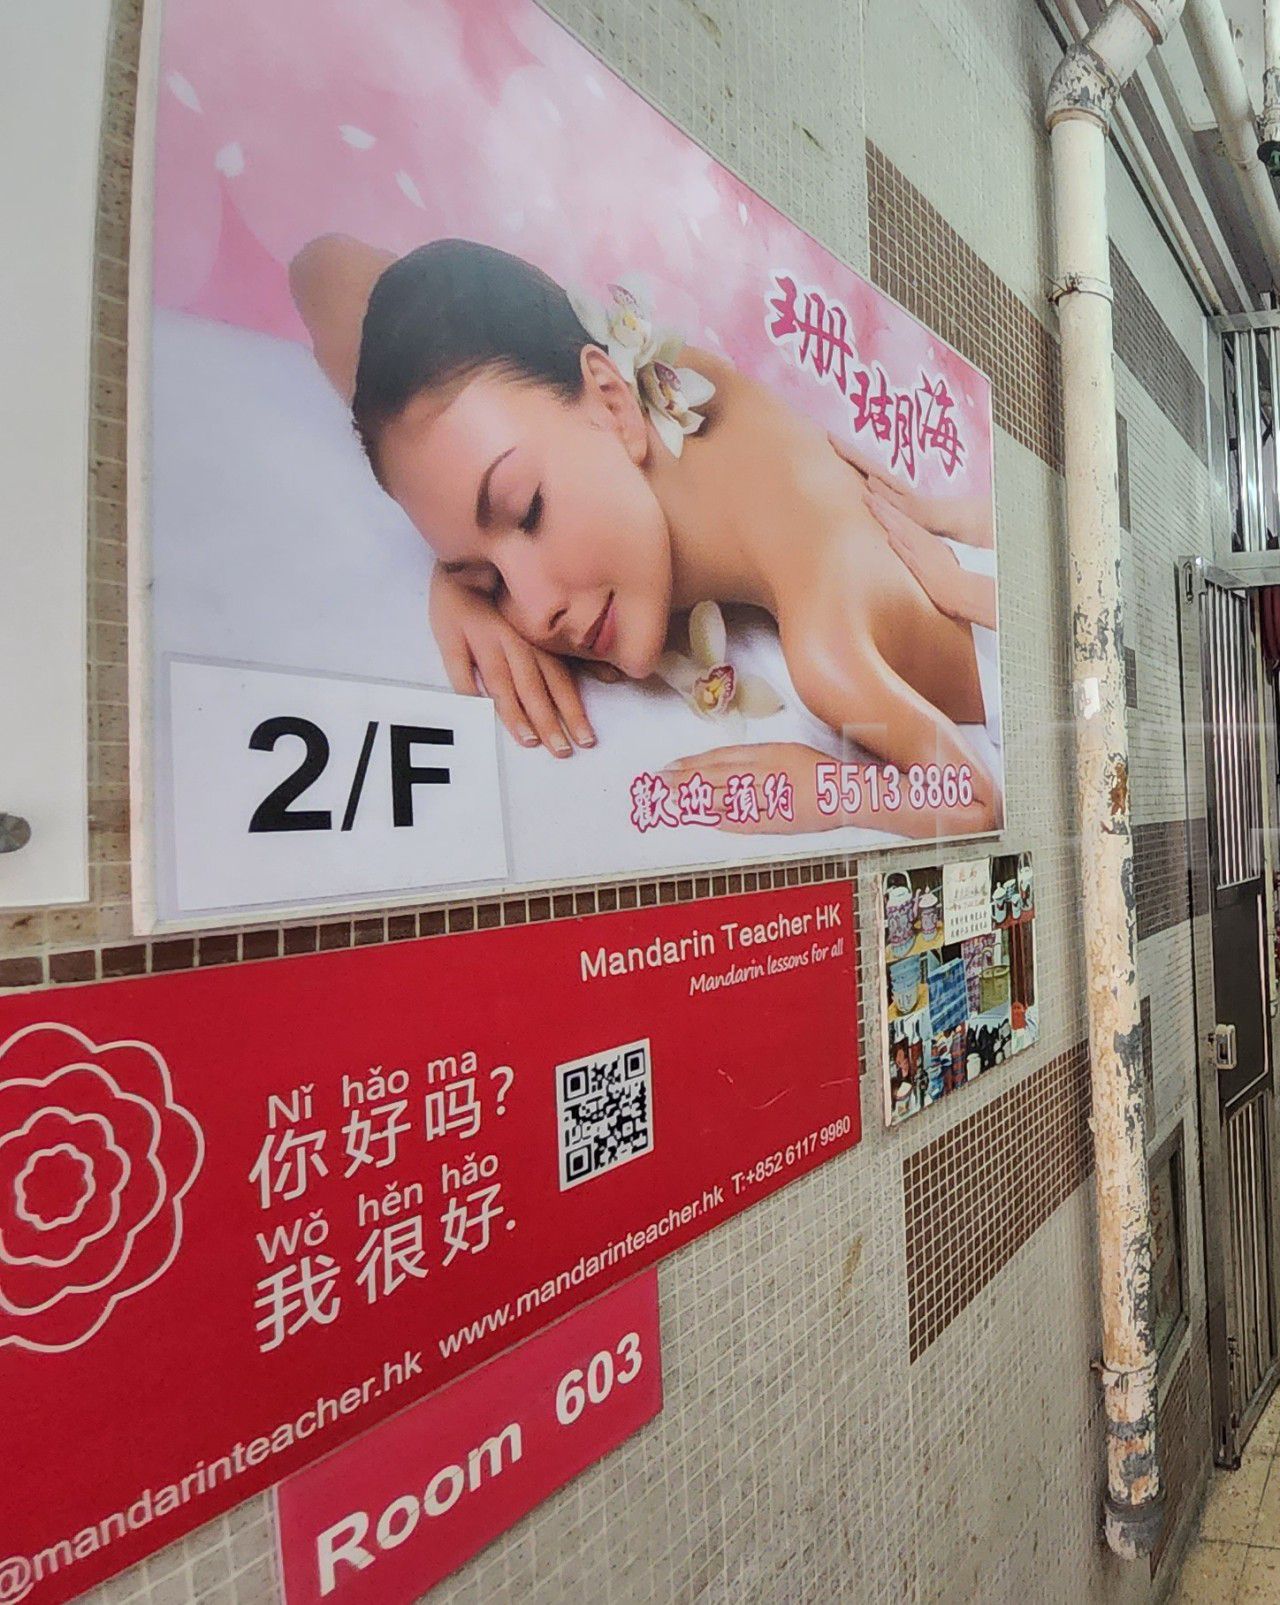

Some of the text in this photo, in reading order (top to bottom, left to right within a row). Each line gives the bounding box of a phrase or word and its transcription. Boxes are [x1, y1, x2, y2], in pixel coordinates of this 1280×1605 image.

[769, 274, 966, 481] 珊瑚海
[248, 716, 454, 833] 2/F
[629, 762, 974, 832] 歡迎預約 5513 8866
[579, 902, 842, 982] Mandarin Teacher HK
[688, 937, 844, 997] Mandarin lessons for all
[427, 1050, 478, 1084] ma
[438, 1185, 725, 1358] www.mandarinteacher.hk
[784, 1131, 819, 1166] 6117
[819, 1114, 851, 1147] 9980
[316, 1331, 643, 1598] Room 603
